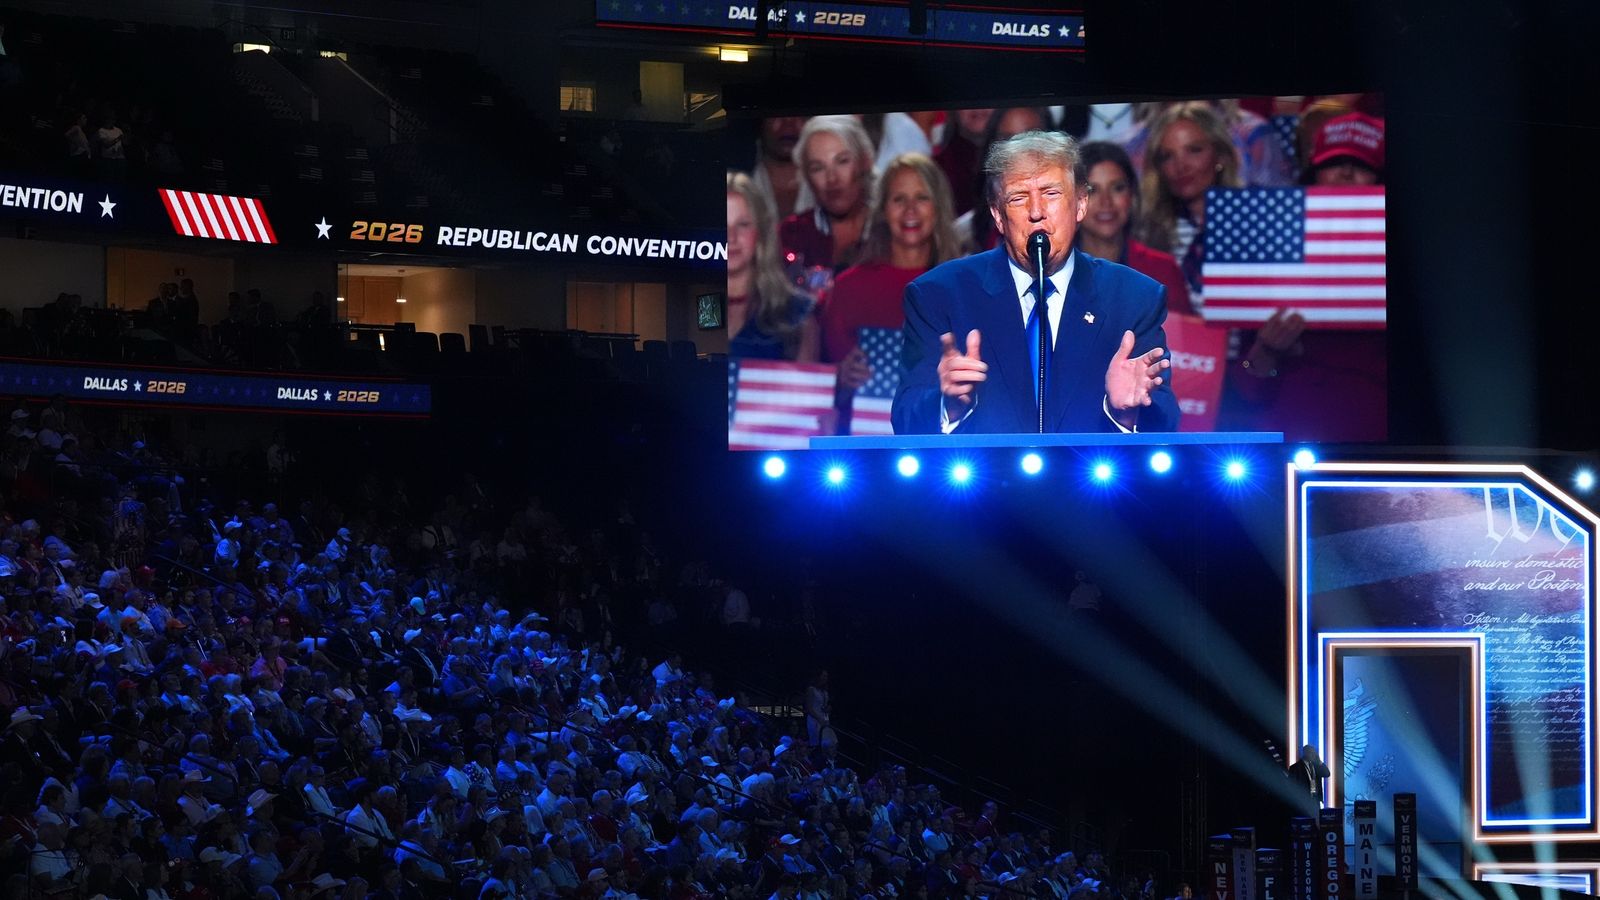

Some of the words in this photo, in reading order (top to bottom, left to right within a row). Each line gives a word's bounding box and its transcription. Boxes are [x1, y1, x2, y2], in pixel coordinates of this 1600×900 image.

[814, 12, 865, 25] 2026
[992, 22, 1050, 36] DALLAS
[351, 221, 423, 242] 2026
[437, 226, 578, 252] REPUBLICAN
[586, 235, 728, 261] CONVENTION
[84, 377, 127, 391] DALLAS
[148, 381, 186, 393] 2026
[278, 388, 318, 400] DALLAS
[338, 391, 379, 402] 2026
[1465, 552, 1512, 568] insure
[1514, 554, 1584, 568] domestic
[1464, 577, 1500, 591] and
[1498, 582, 1524, 591] our
[1400, 815, 1412, 884] VERMONT
[1359, 824, 1373, 894] MAINE
